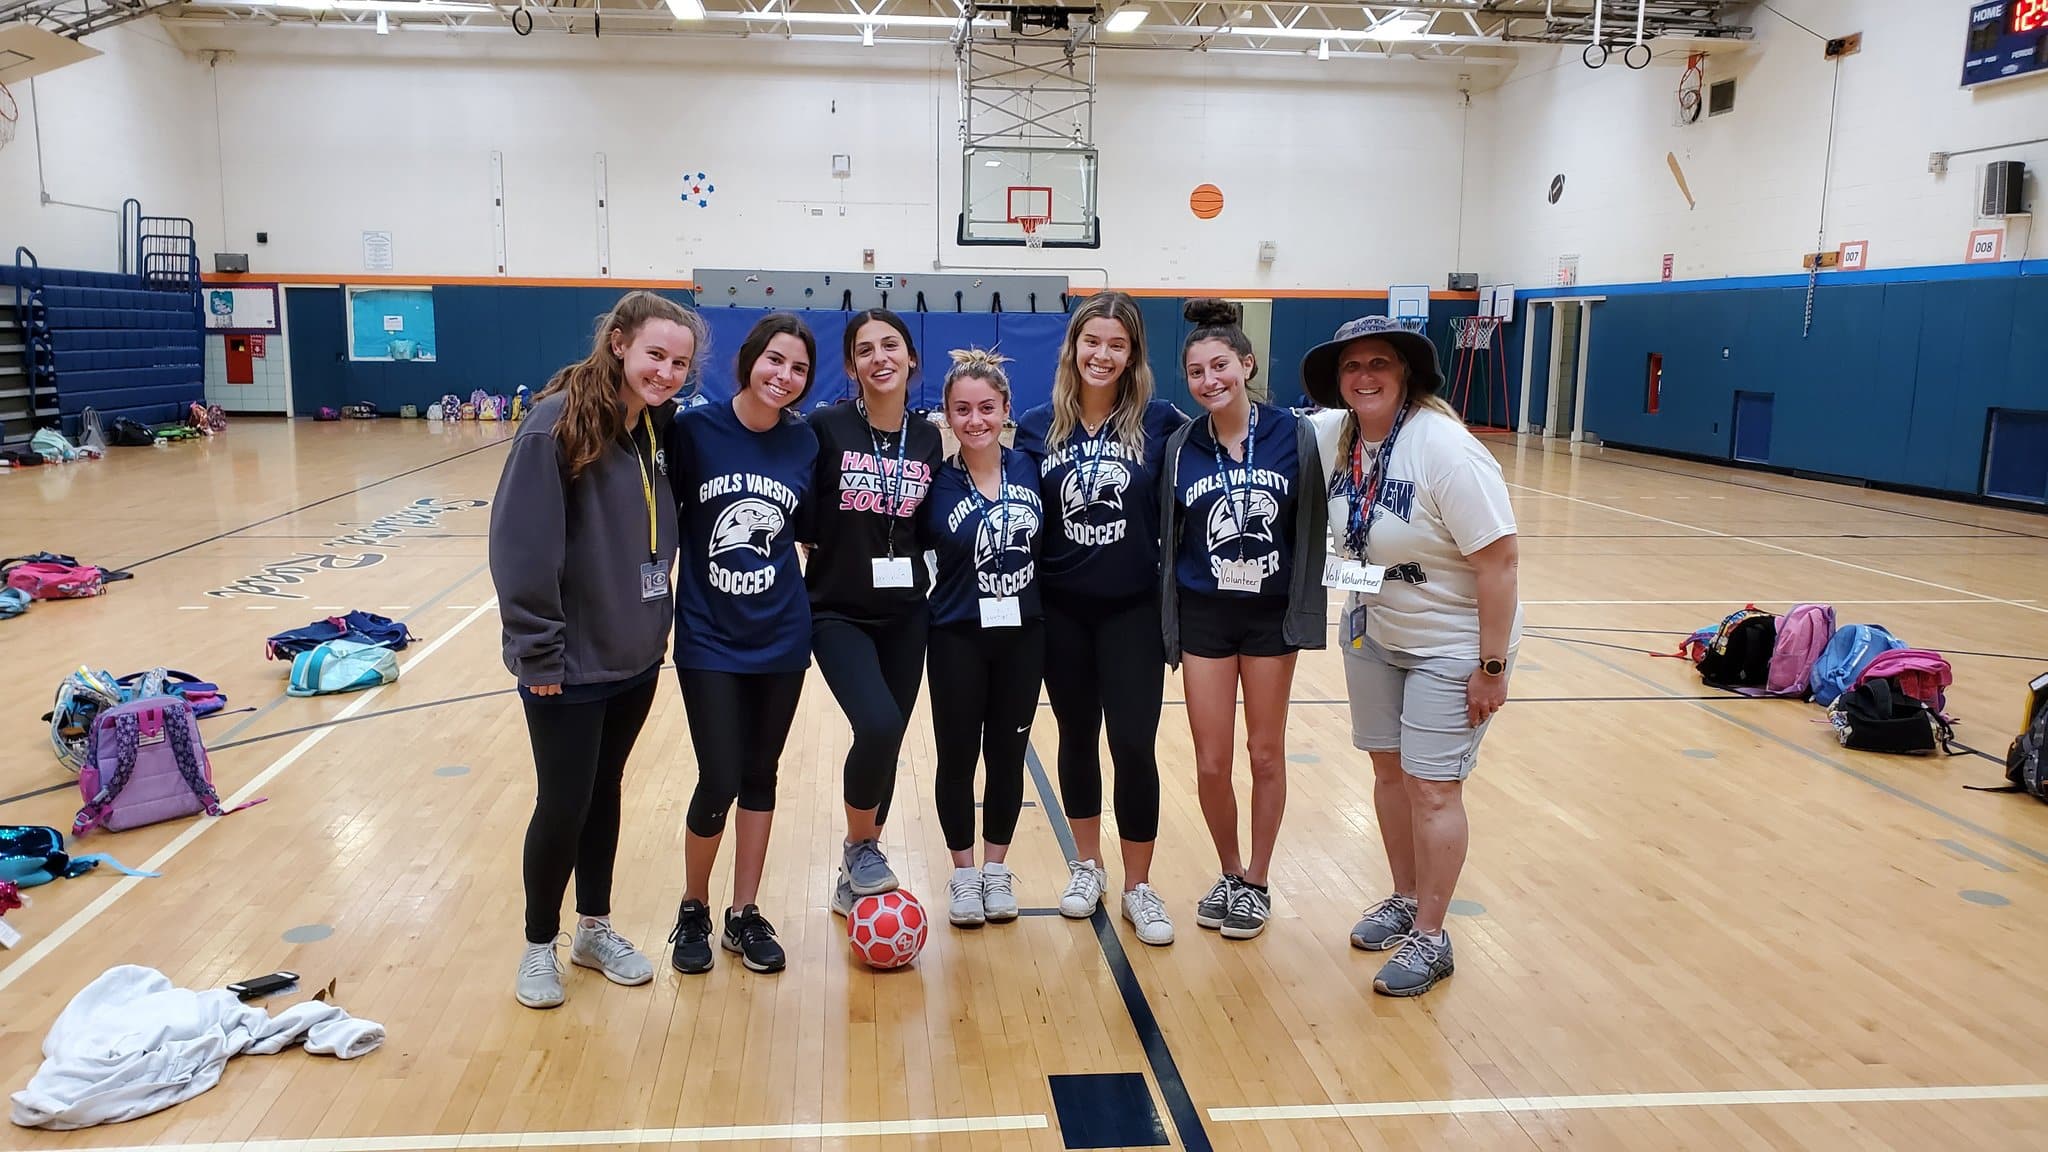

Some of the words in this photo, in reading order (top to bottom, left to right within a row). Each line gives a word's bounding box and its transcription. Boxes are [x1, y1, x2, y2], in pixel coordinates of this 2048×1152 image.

[1973, 4, 2003, 23] HOME
[1845, 251, 1859, 262] 007
[1975, 241, 1993, 253] 008
[840, 450, 922, 480] HAWKS
[1041, 444, 1079, 479] GIRLS
[699, 473, 742, 504] GIRLS
[746, 472, 799, 515] VARSITY
[1185, 473, 1223, 508] GIRLS
[1228, 468, 1289, 496] VARSITY
[948, 496, 984, 533] GIRL
[1063, 518, 1127, 546] SOCCER
[708, 560, 776, 596] SOCCER
[978, 560, 1034, 596] SOCCER
[1221, 567, 1260, 586] Volunteer
[1341, 571, 1382, 588] Volunteer
